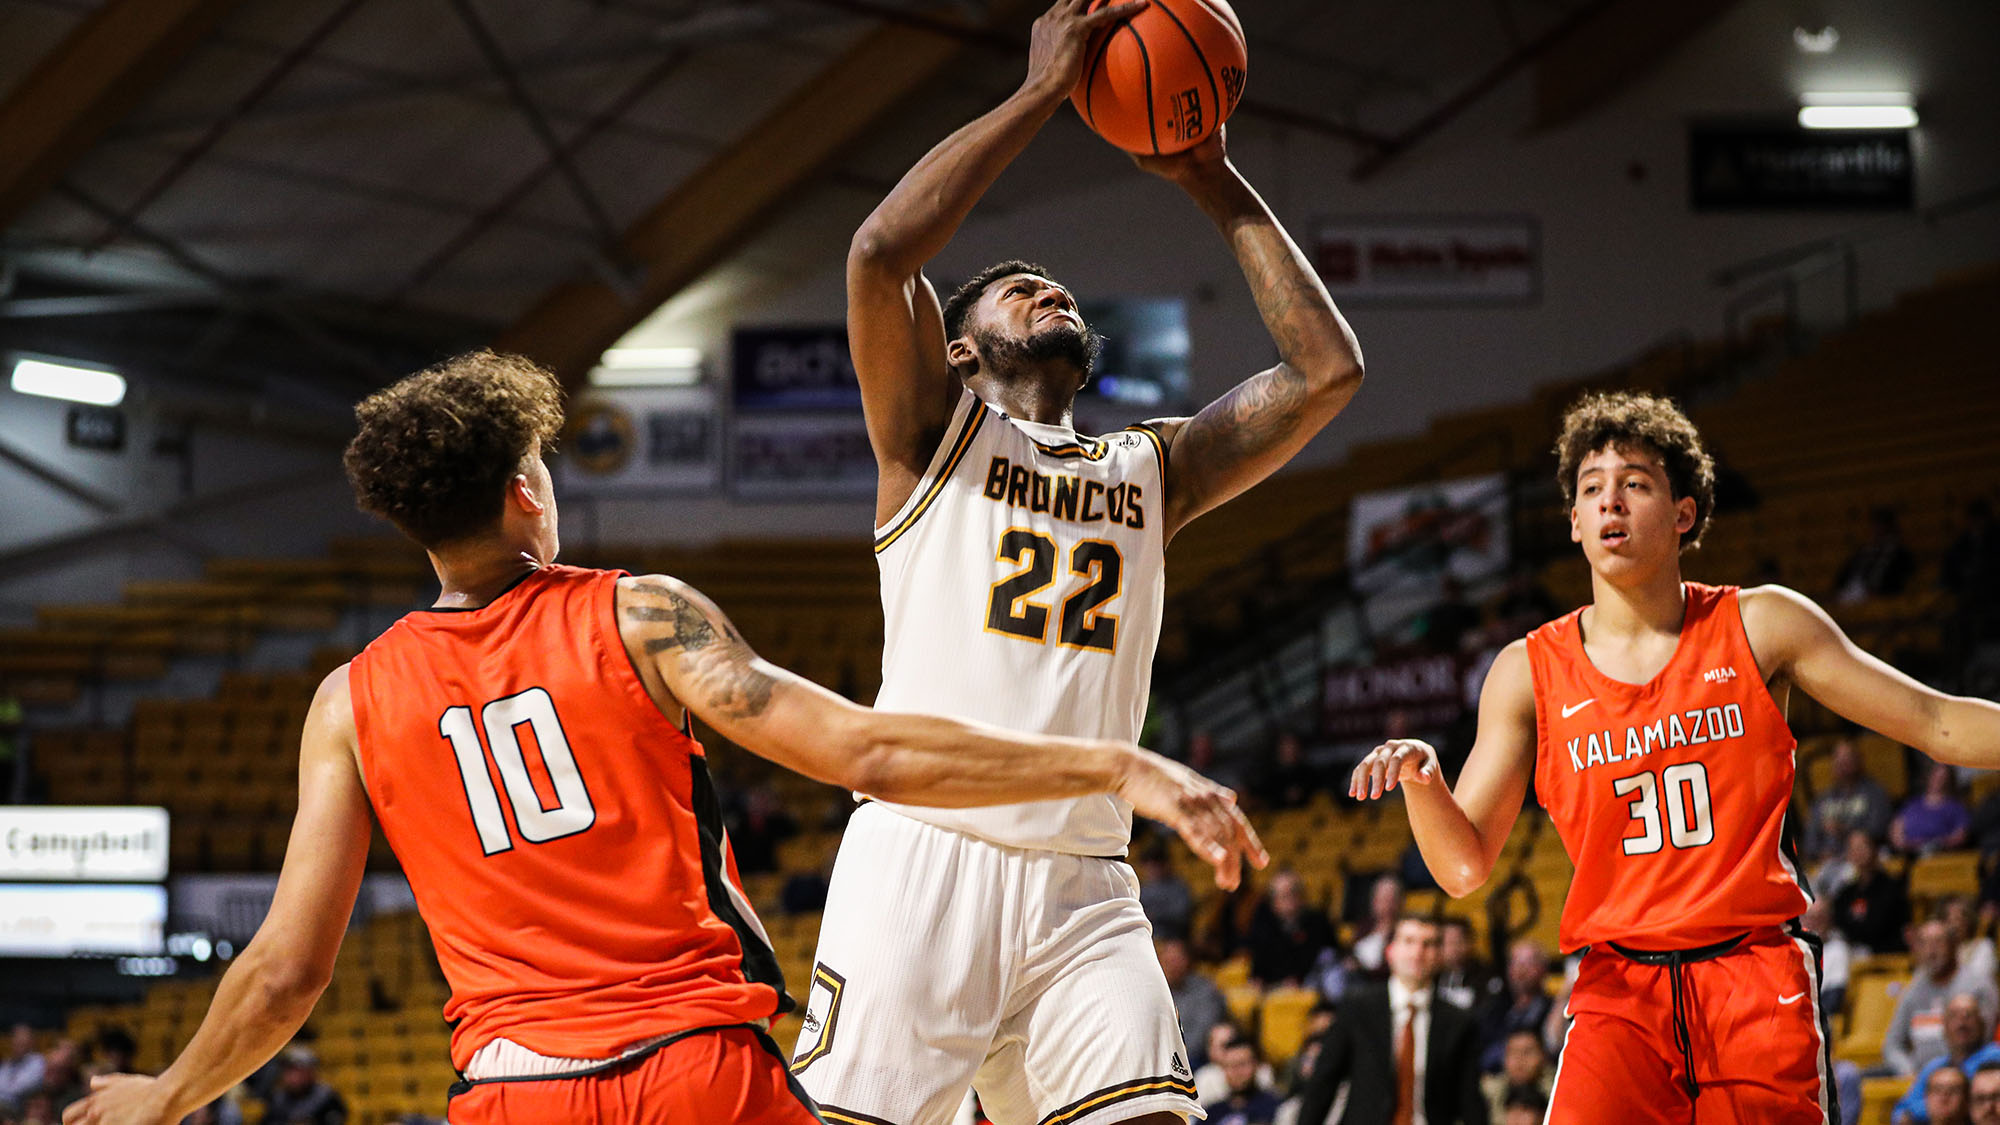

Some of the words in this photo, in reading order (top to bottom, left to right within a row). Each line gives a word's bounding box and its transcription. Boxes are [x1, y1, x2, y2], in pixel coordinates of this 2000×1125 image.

[983, 456, 1145, 530] BRONCOS
[983, 526, 1123, 656] 22
[1703, 666, 1737, 682] MIAA
[438, 686, 596, 857] 10
[1567, 703, 1745, 773] KALAMAZOO
[1612, 761, 1715, 856] 30
